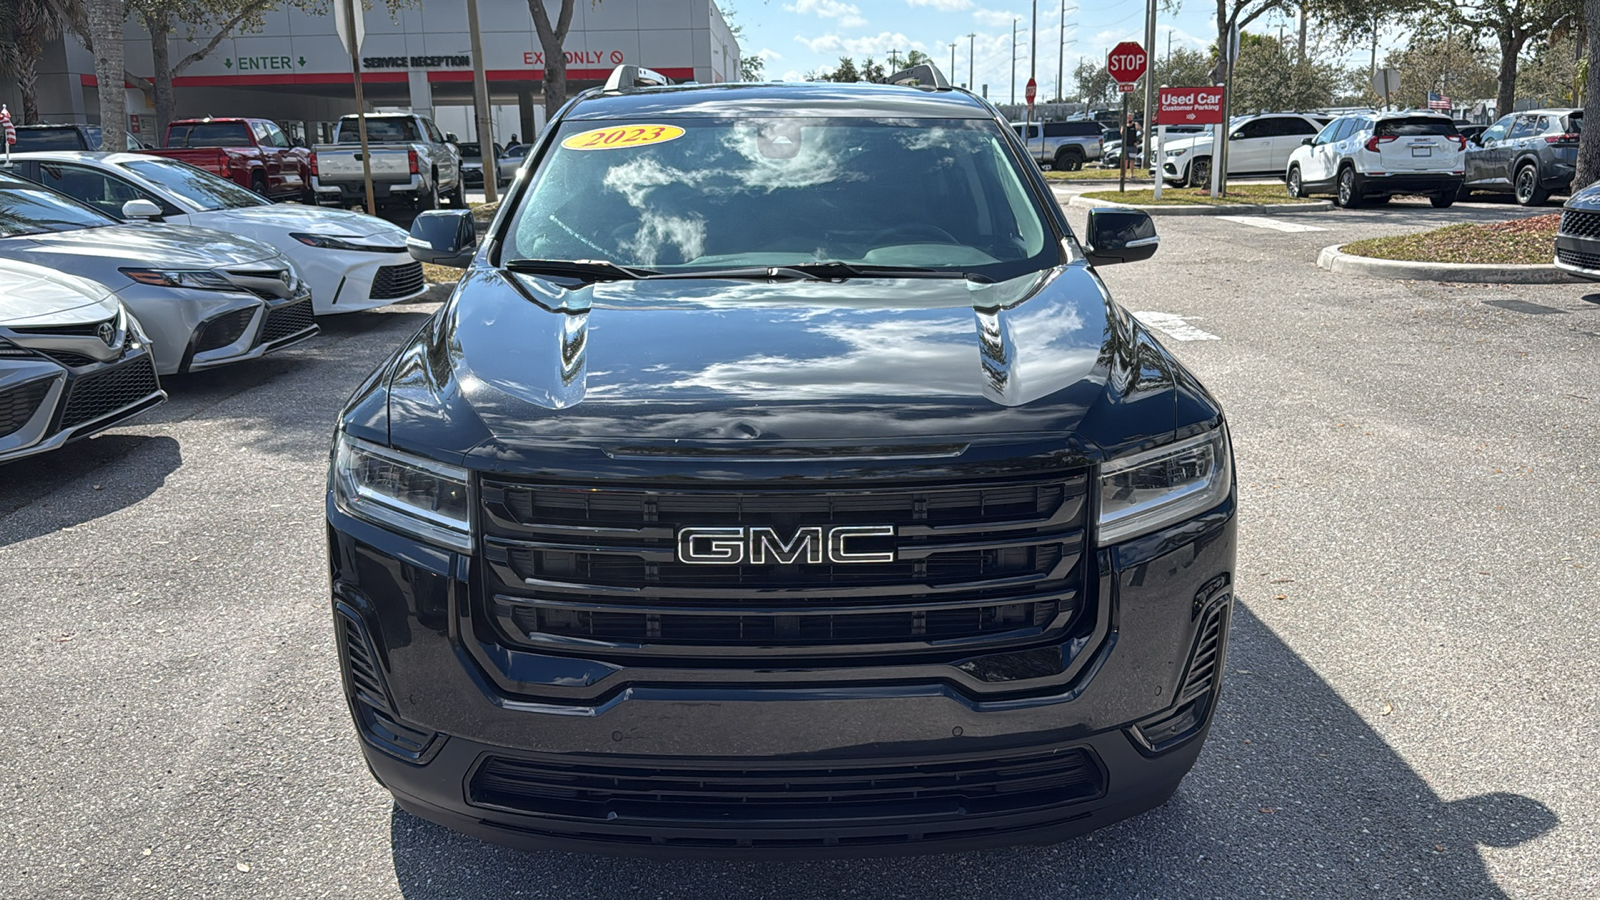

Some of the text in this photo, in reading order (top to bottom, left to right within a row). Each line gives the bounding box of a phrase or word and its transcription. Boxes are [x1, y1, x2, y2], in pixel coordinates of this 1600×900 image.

[238, 56, 292, 70] ENTER
[362, 55, 470, 69] SERVICE RECEPTION
[1110, 54, 1145, 71] STOP
[1161, 92, 1221, 105] Used Car
[582, 127, 667, 147] 2023
[677, 525, 895, 565] GMC
